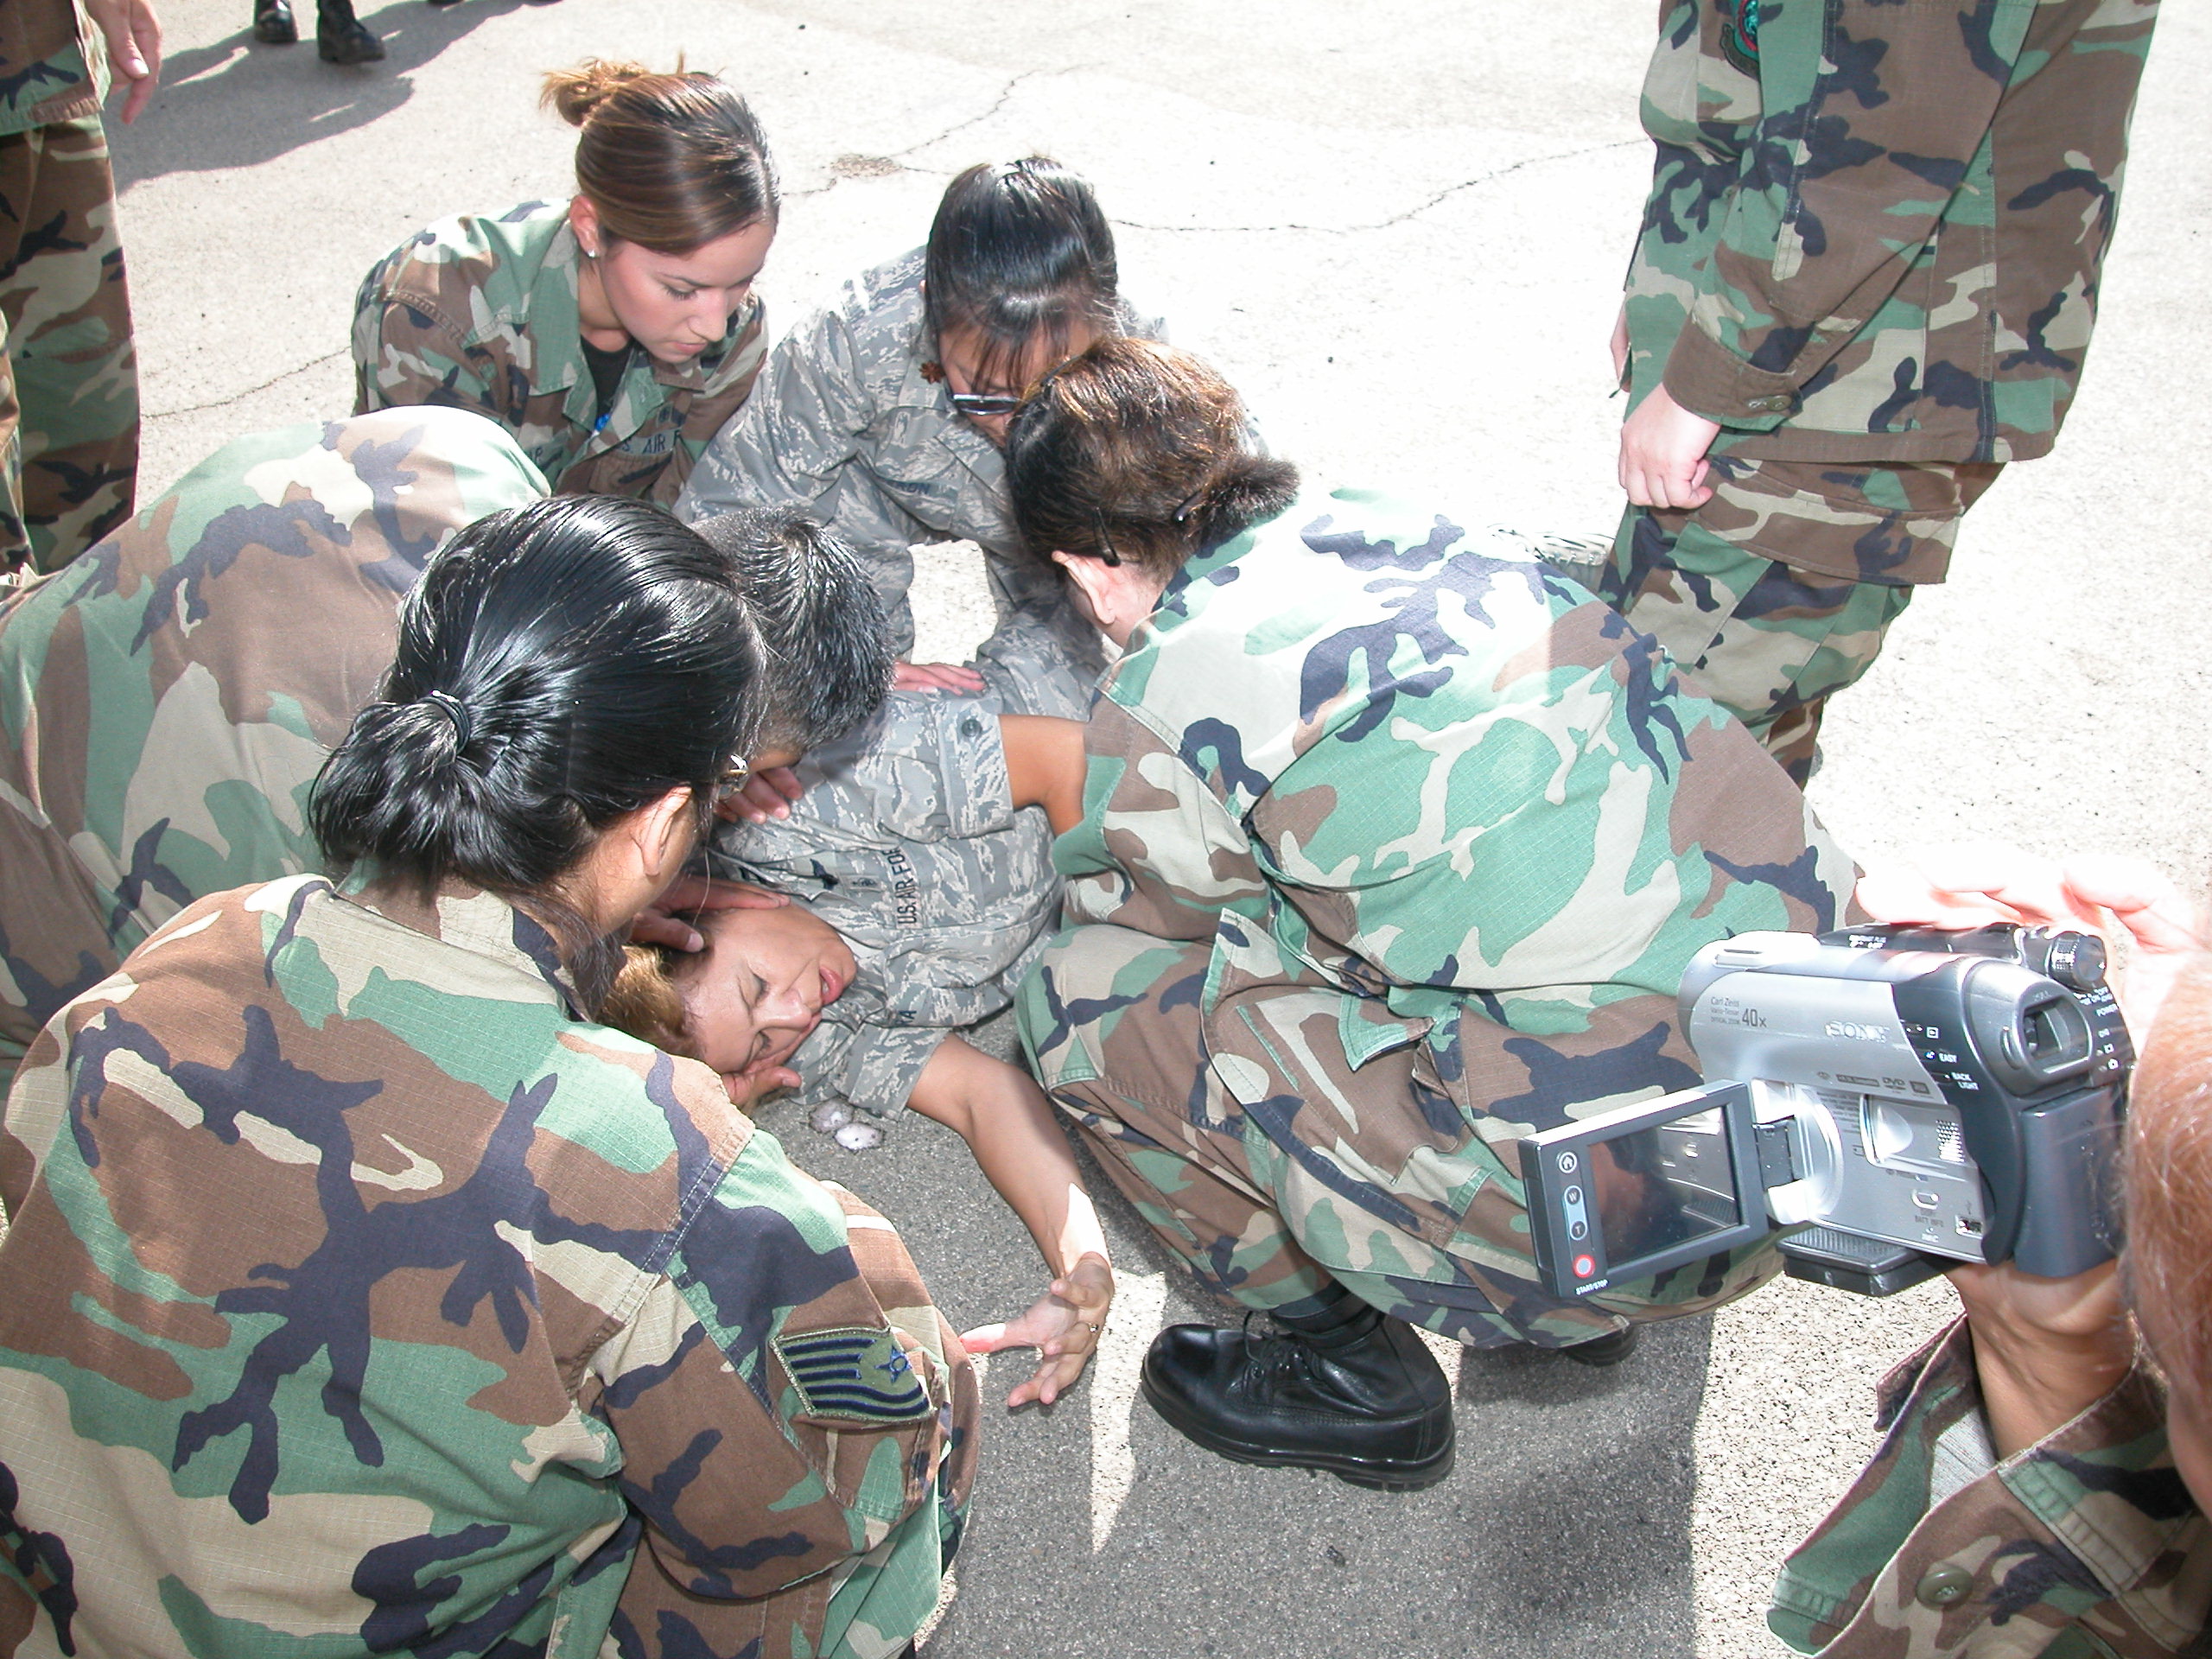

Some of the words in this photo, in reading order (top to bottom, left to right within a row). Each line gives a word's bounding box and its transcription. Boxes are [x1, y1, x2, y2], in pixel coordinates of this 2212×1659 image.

[642, 433, 665, 454] AIR
[895, 877, 917, 899] AIR
[896, 901, 918, 925] U.S.
[1741, 1008, 1767, 1028] 40x
[1938, 1052, 1958, 1064] EASY
[1568, 1192, 1578, 1203] W
[1575, 1225, 1582, 1236] T
